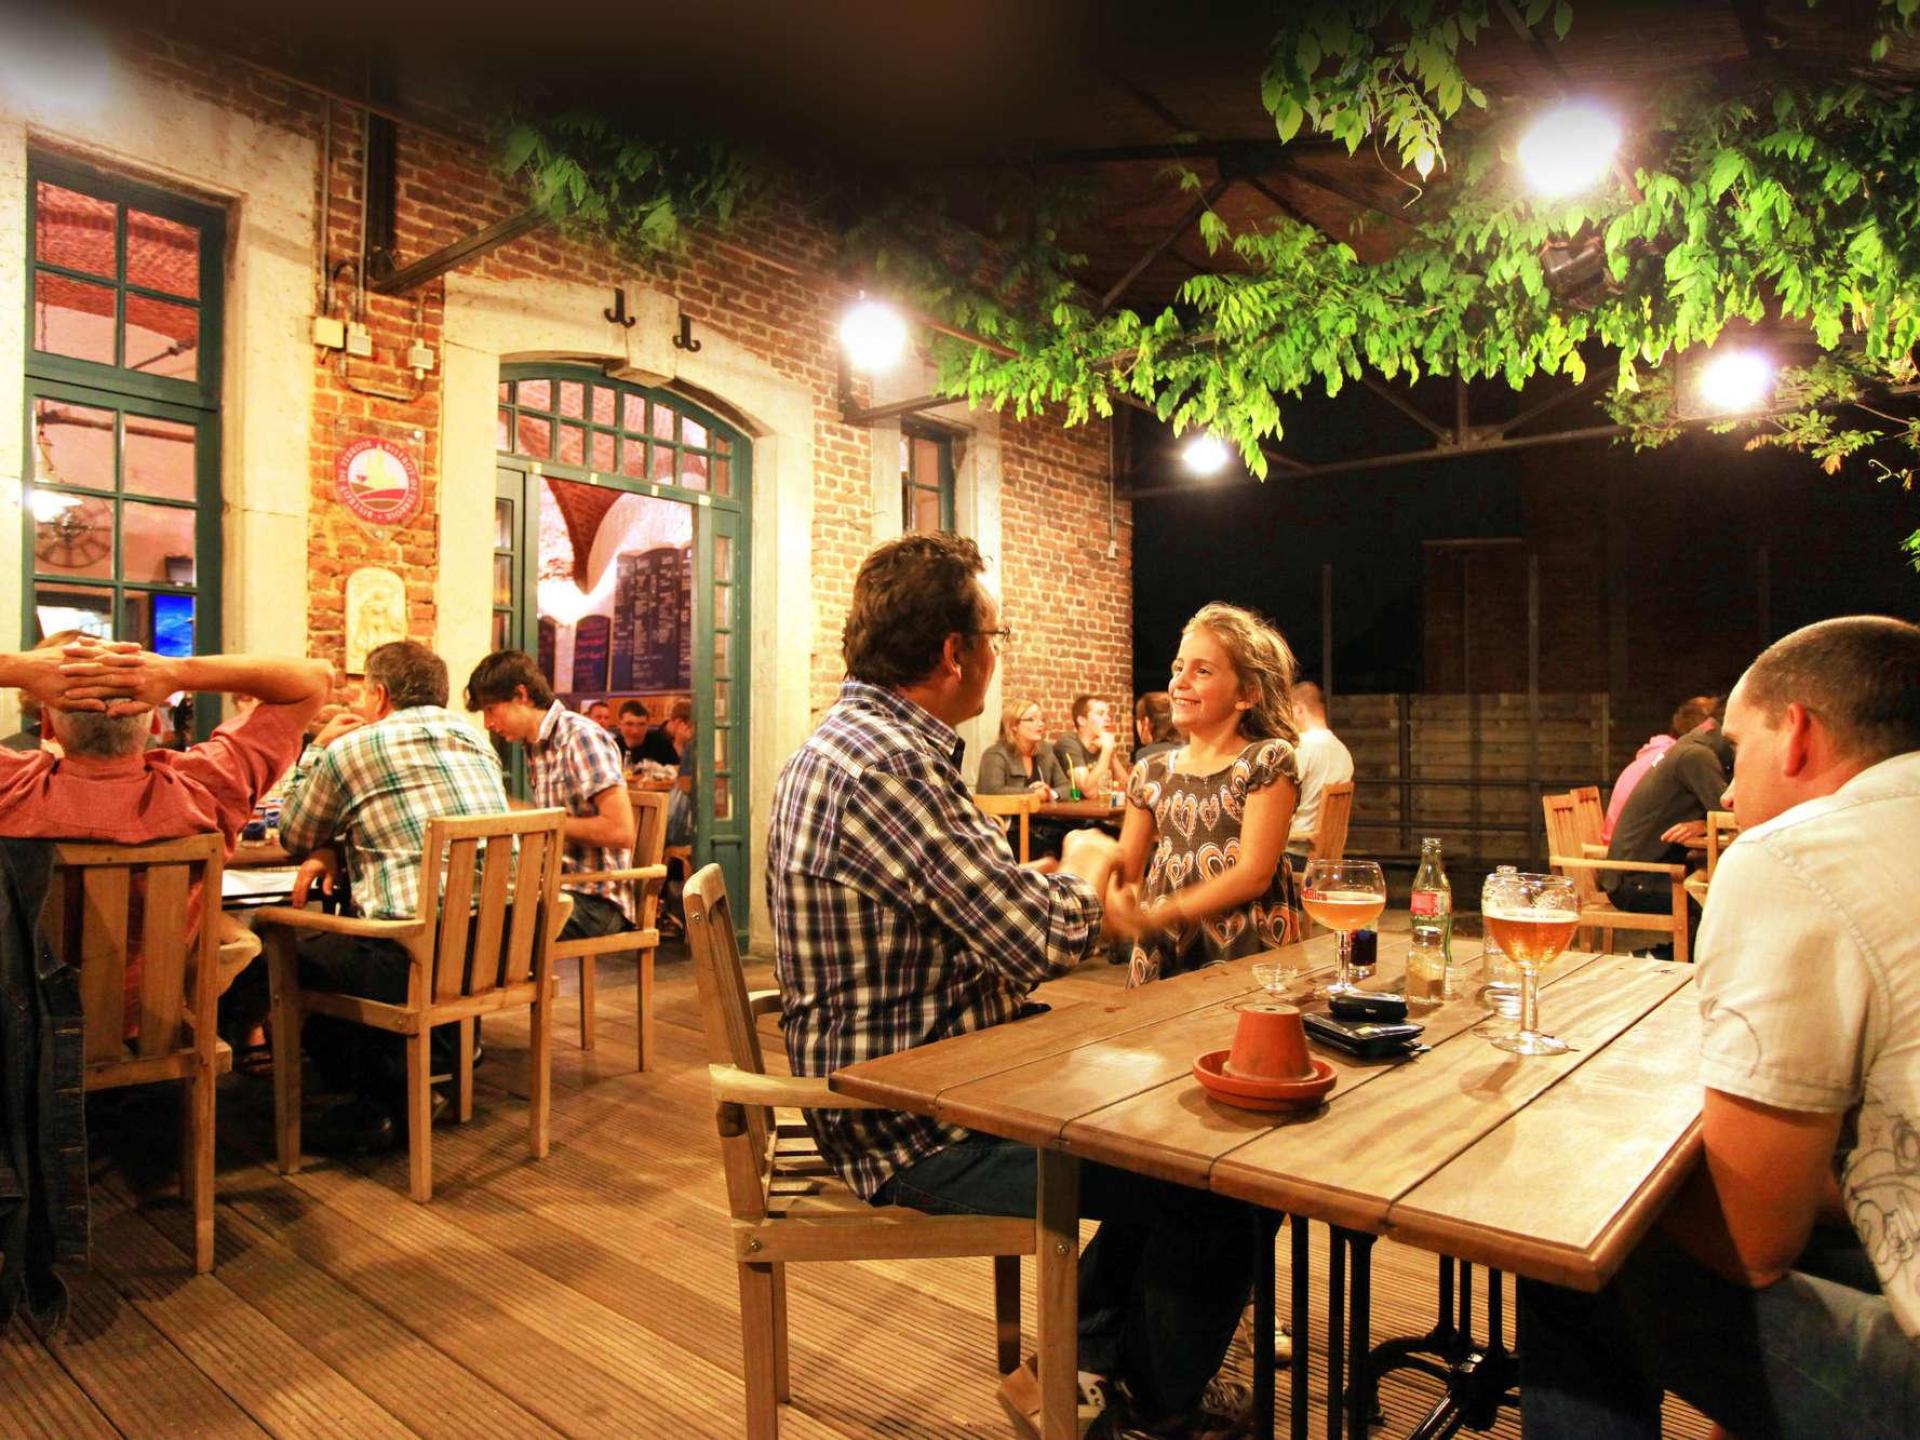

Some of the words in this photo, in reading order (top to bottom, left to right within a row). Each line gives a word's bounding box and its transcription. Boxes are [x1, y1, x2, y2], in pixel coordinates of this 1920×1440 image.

[340, 440, 372, 467] TERROIR
[384, 442, 416, 476] BISTROT
[338, 469, 347, 482] DE
[409, 479, 418, 492] DE
[340, 485, 374, 519] BISTROT
[385, 492, 416, 521] TERROIR
